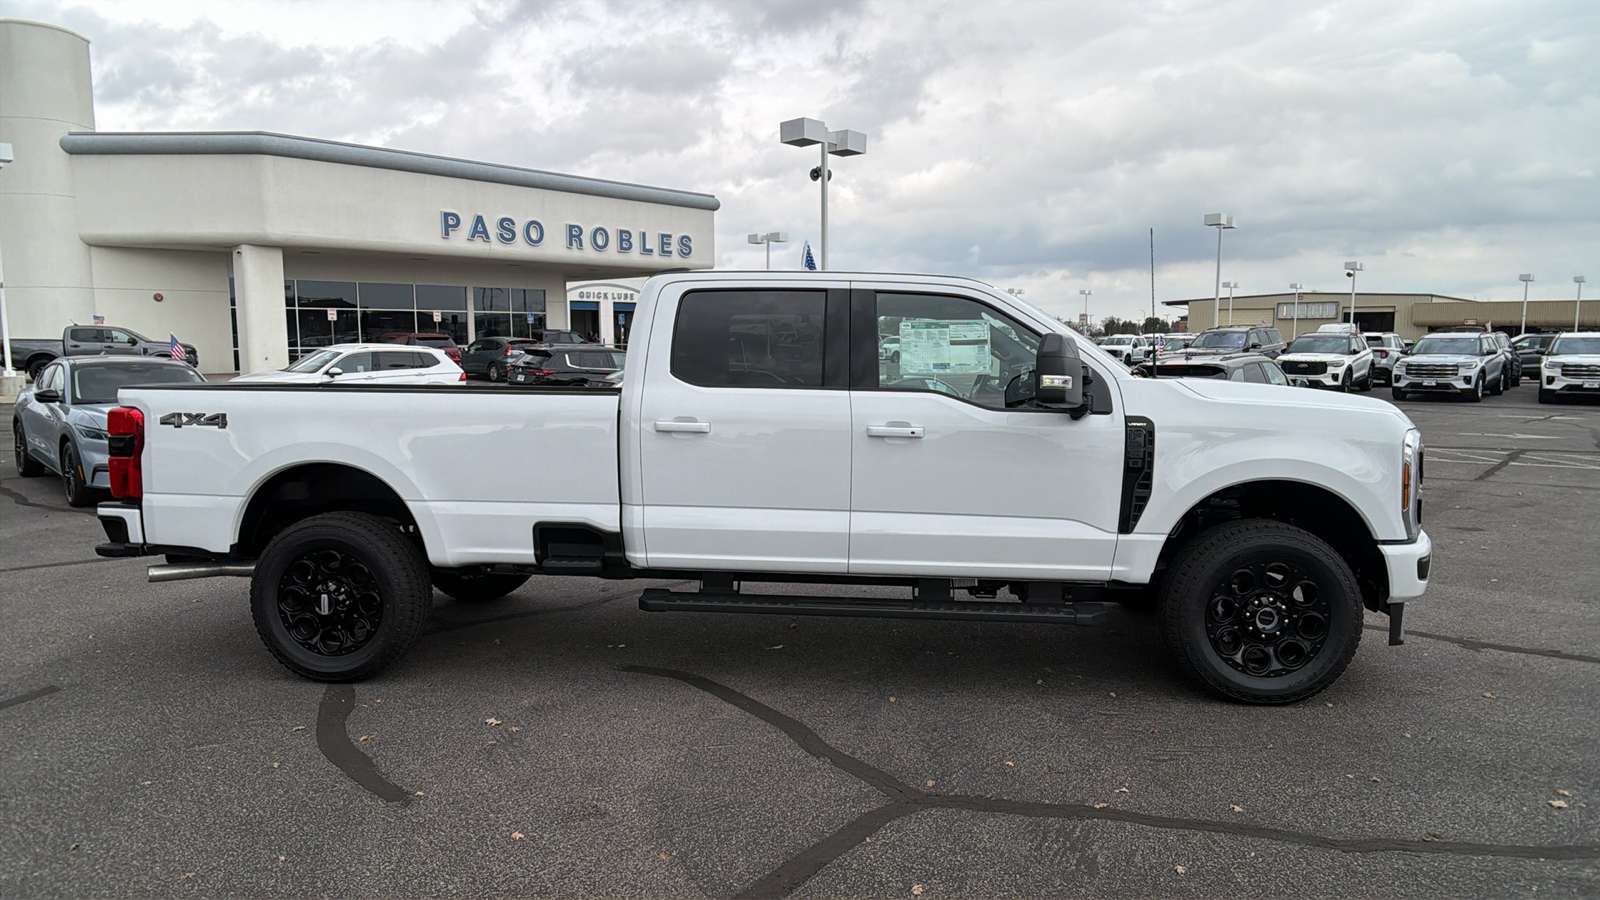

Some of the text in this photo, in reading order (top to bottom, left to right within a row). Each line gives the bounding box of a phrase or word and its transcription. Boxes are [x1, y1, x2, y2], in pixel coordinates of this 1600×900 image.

[441, 211, 693, 258] PASO ROBLES
[578, 291, 635, 301] QUICK LUBE
